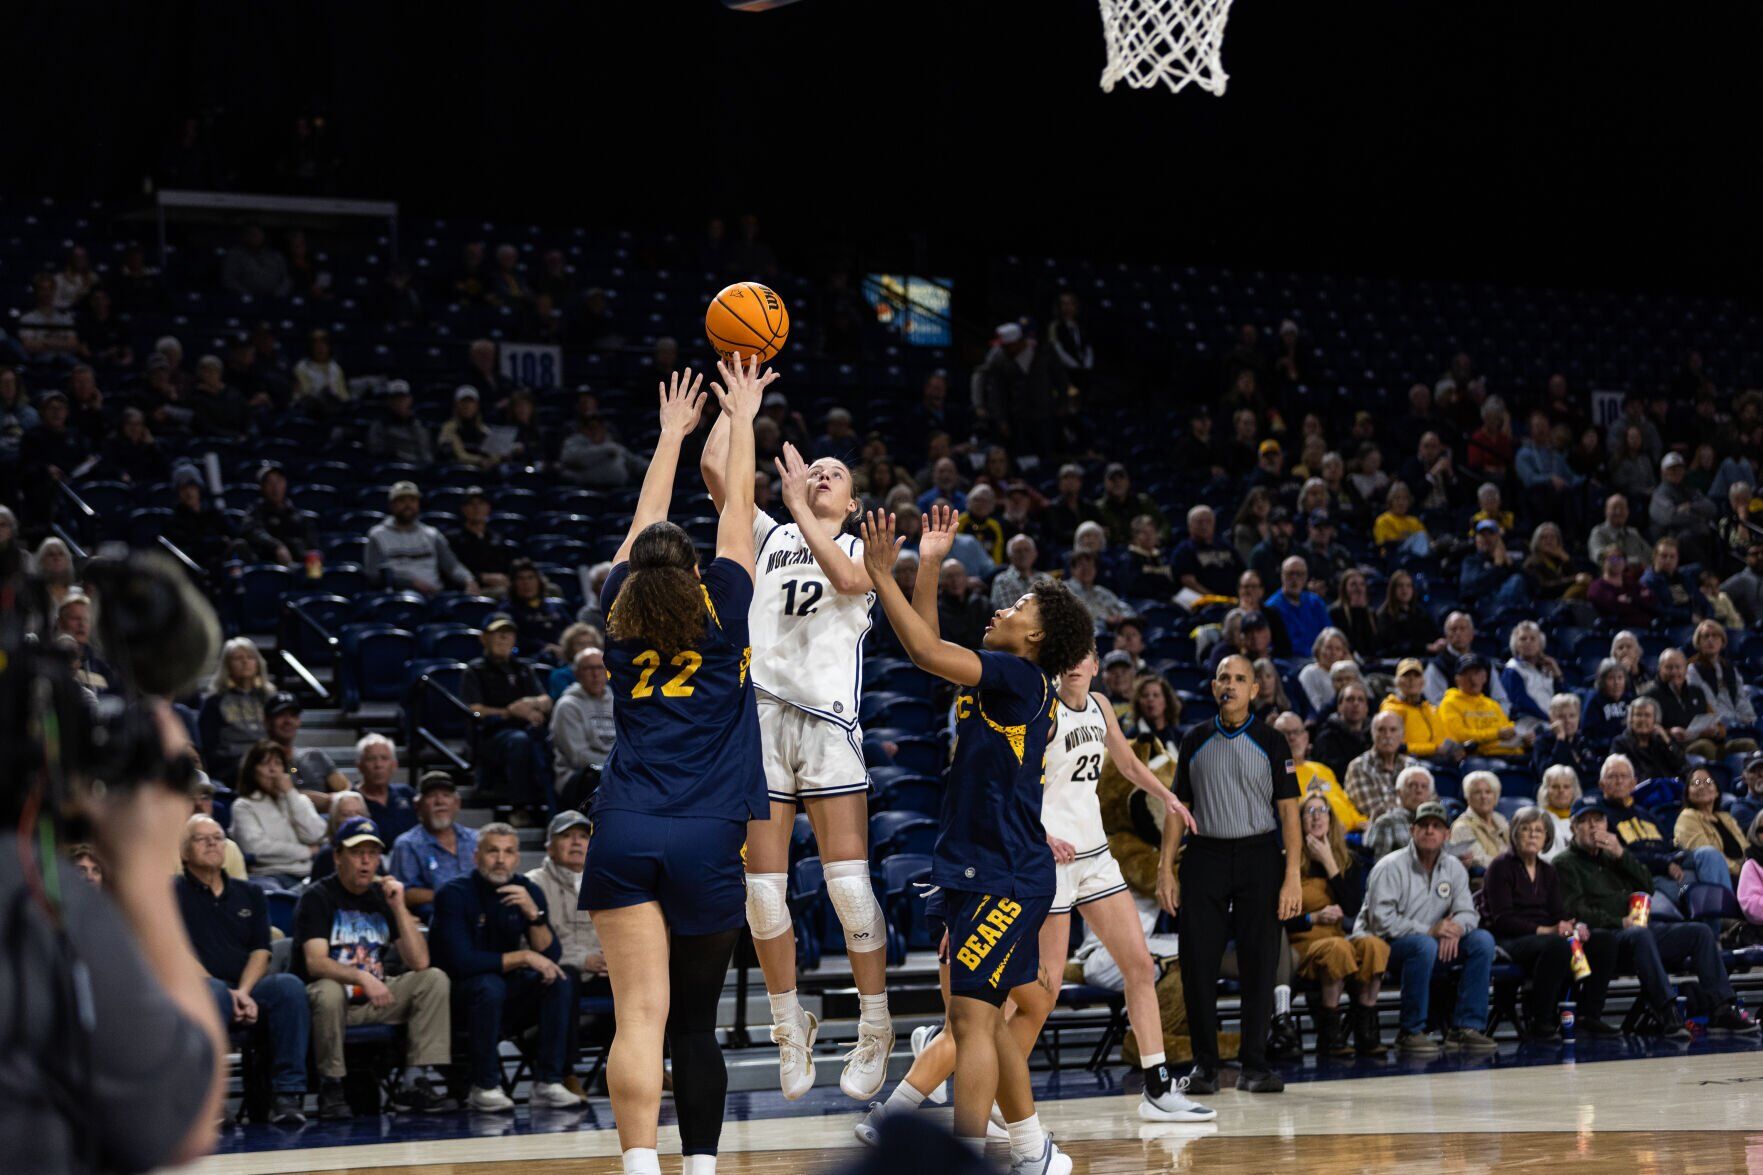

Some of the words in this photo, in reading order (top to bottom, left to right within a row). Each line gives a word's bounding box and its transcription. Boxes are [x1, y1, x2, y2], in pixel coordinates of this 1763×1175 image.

[509, 352, 555, 387] 108
[765, 547, 814, 575] MONTANA
[781, 579, 823, 616] 12
[630, 649, 702, 699] 22
[1064, 726, 1093, 753] MONTANA
[1071, 753, 1101, 782] 23
[956, 897, 1022, 972] BEARS
